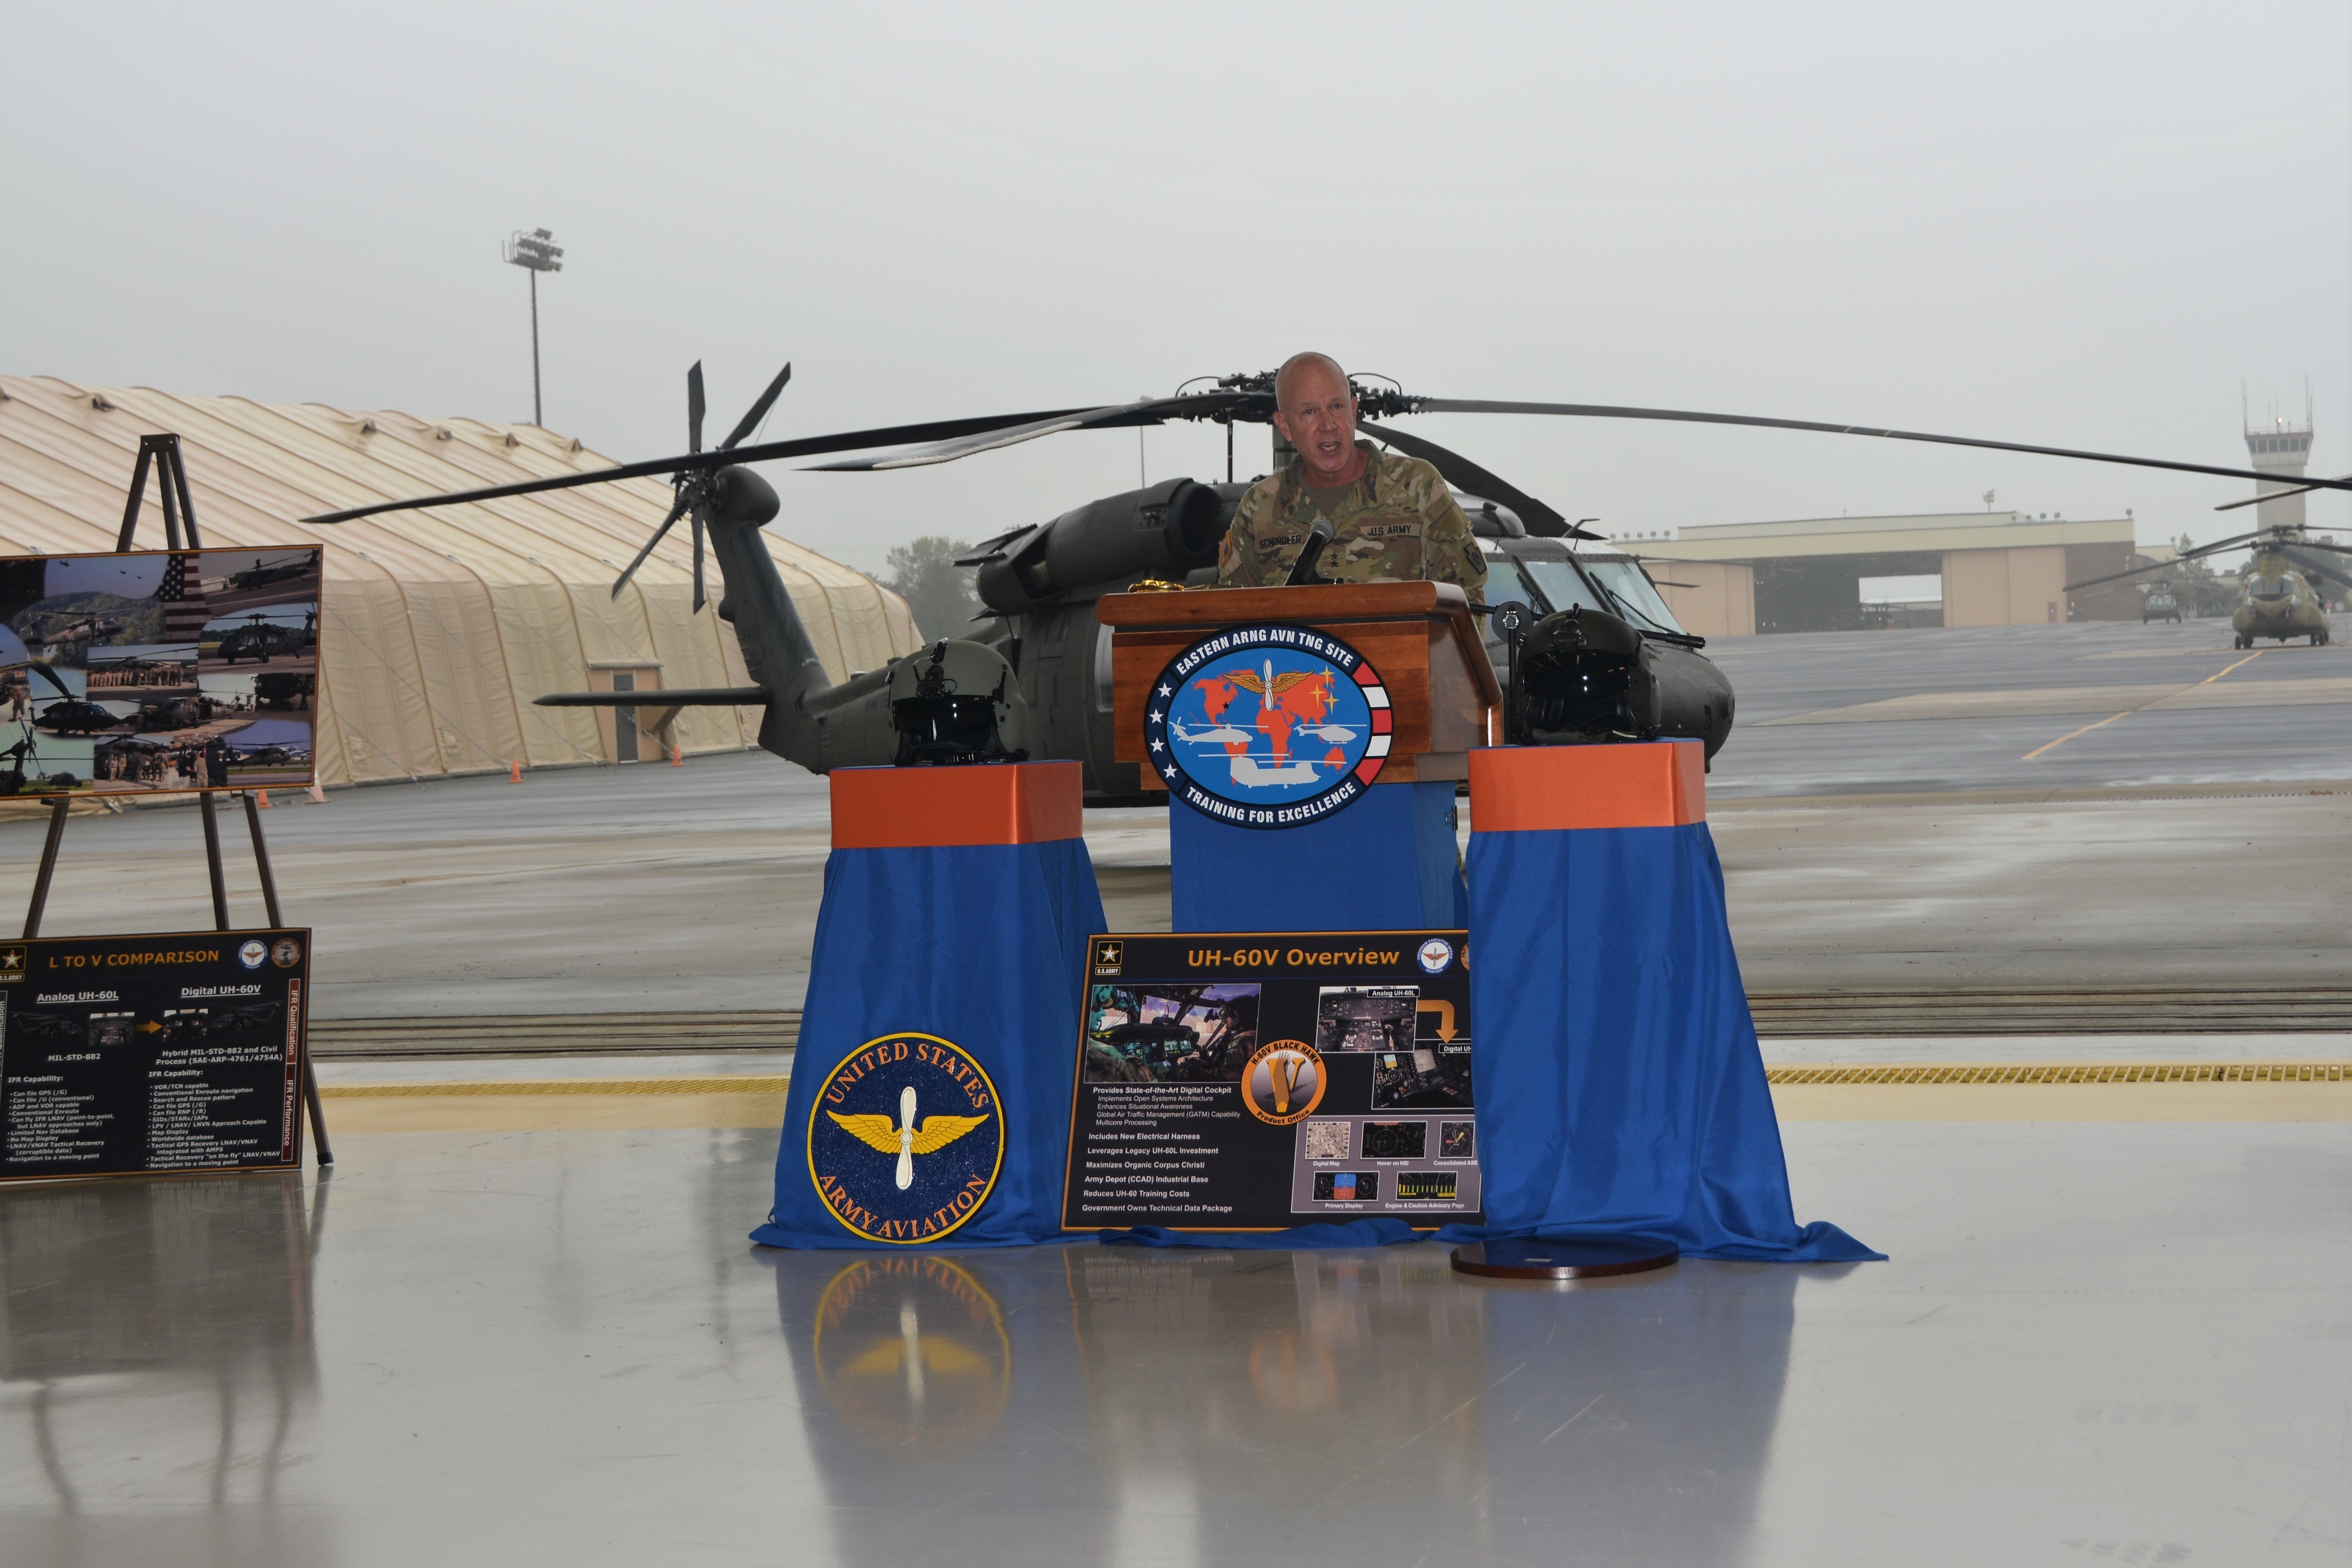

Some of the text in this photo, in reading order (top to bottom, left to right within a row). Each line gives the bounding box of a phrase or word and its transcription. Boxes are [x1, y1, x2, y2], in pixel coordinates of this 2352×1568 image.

[1371, 525, 1411, 536] U.S. ARMY
[1259, 535, 1301, 549] SCHINDLER
[1176, 629, 1353, 675] EASTERN ARNG AVN TNG SITE
[1187, 782, 1356, 823] TRAINING FOR EXCELLENCE
[1188, 948, 1399, 967] UH-60V Overview
[1417, 941, 1428, 960] PROGRAM
[49, 950, 219, 968] L TO V COMPARISON
[37, 990, 119, 1002] Analog UH-60L
[181, 984, 261, 996] Digital UH-60V
[289, 1005, 297, 1055] Qualification
[48, 1053, 100, 1061] MIL-STD-882
[188, 1054, 282, 1064] (SAE-ARP-4761/4754A)
[190, 1047, 242, 1055] MIL-STD-882
[1251, 1042, 1320, 1065] H-60V BLACK HAWK
[826, 1043, 988, 1108] UNITED STATES
[284, 1095, 293, 1146] Performance
[1257, 1109, 1309, 1124] Product Office
[1124, 1161, 1152, 1169] Organic
[1139, 1190, 1167, 1198] Training
[820, 1173, 986, 1238] ARMY AVIATION
